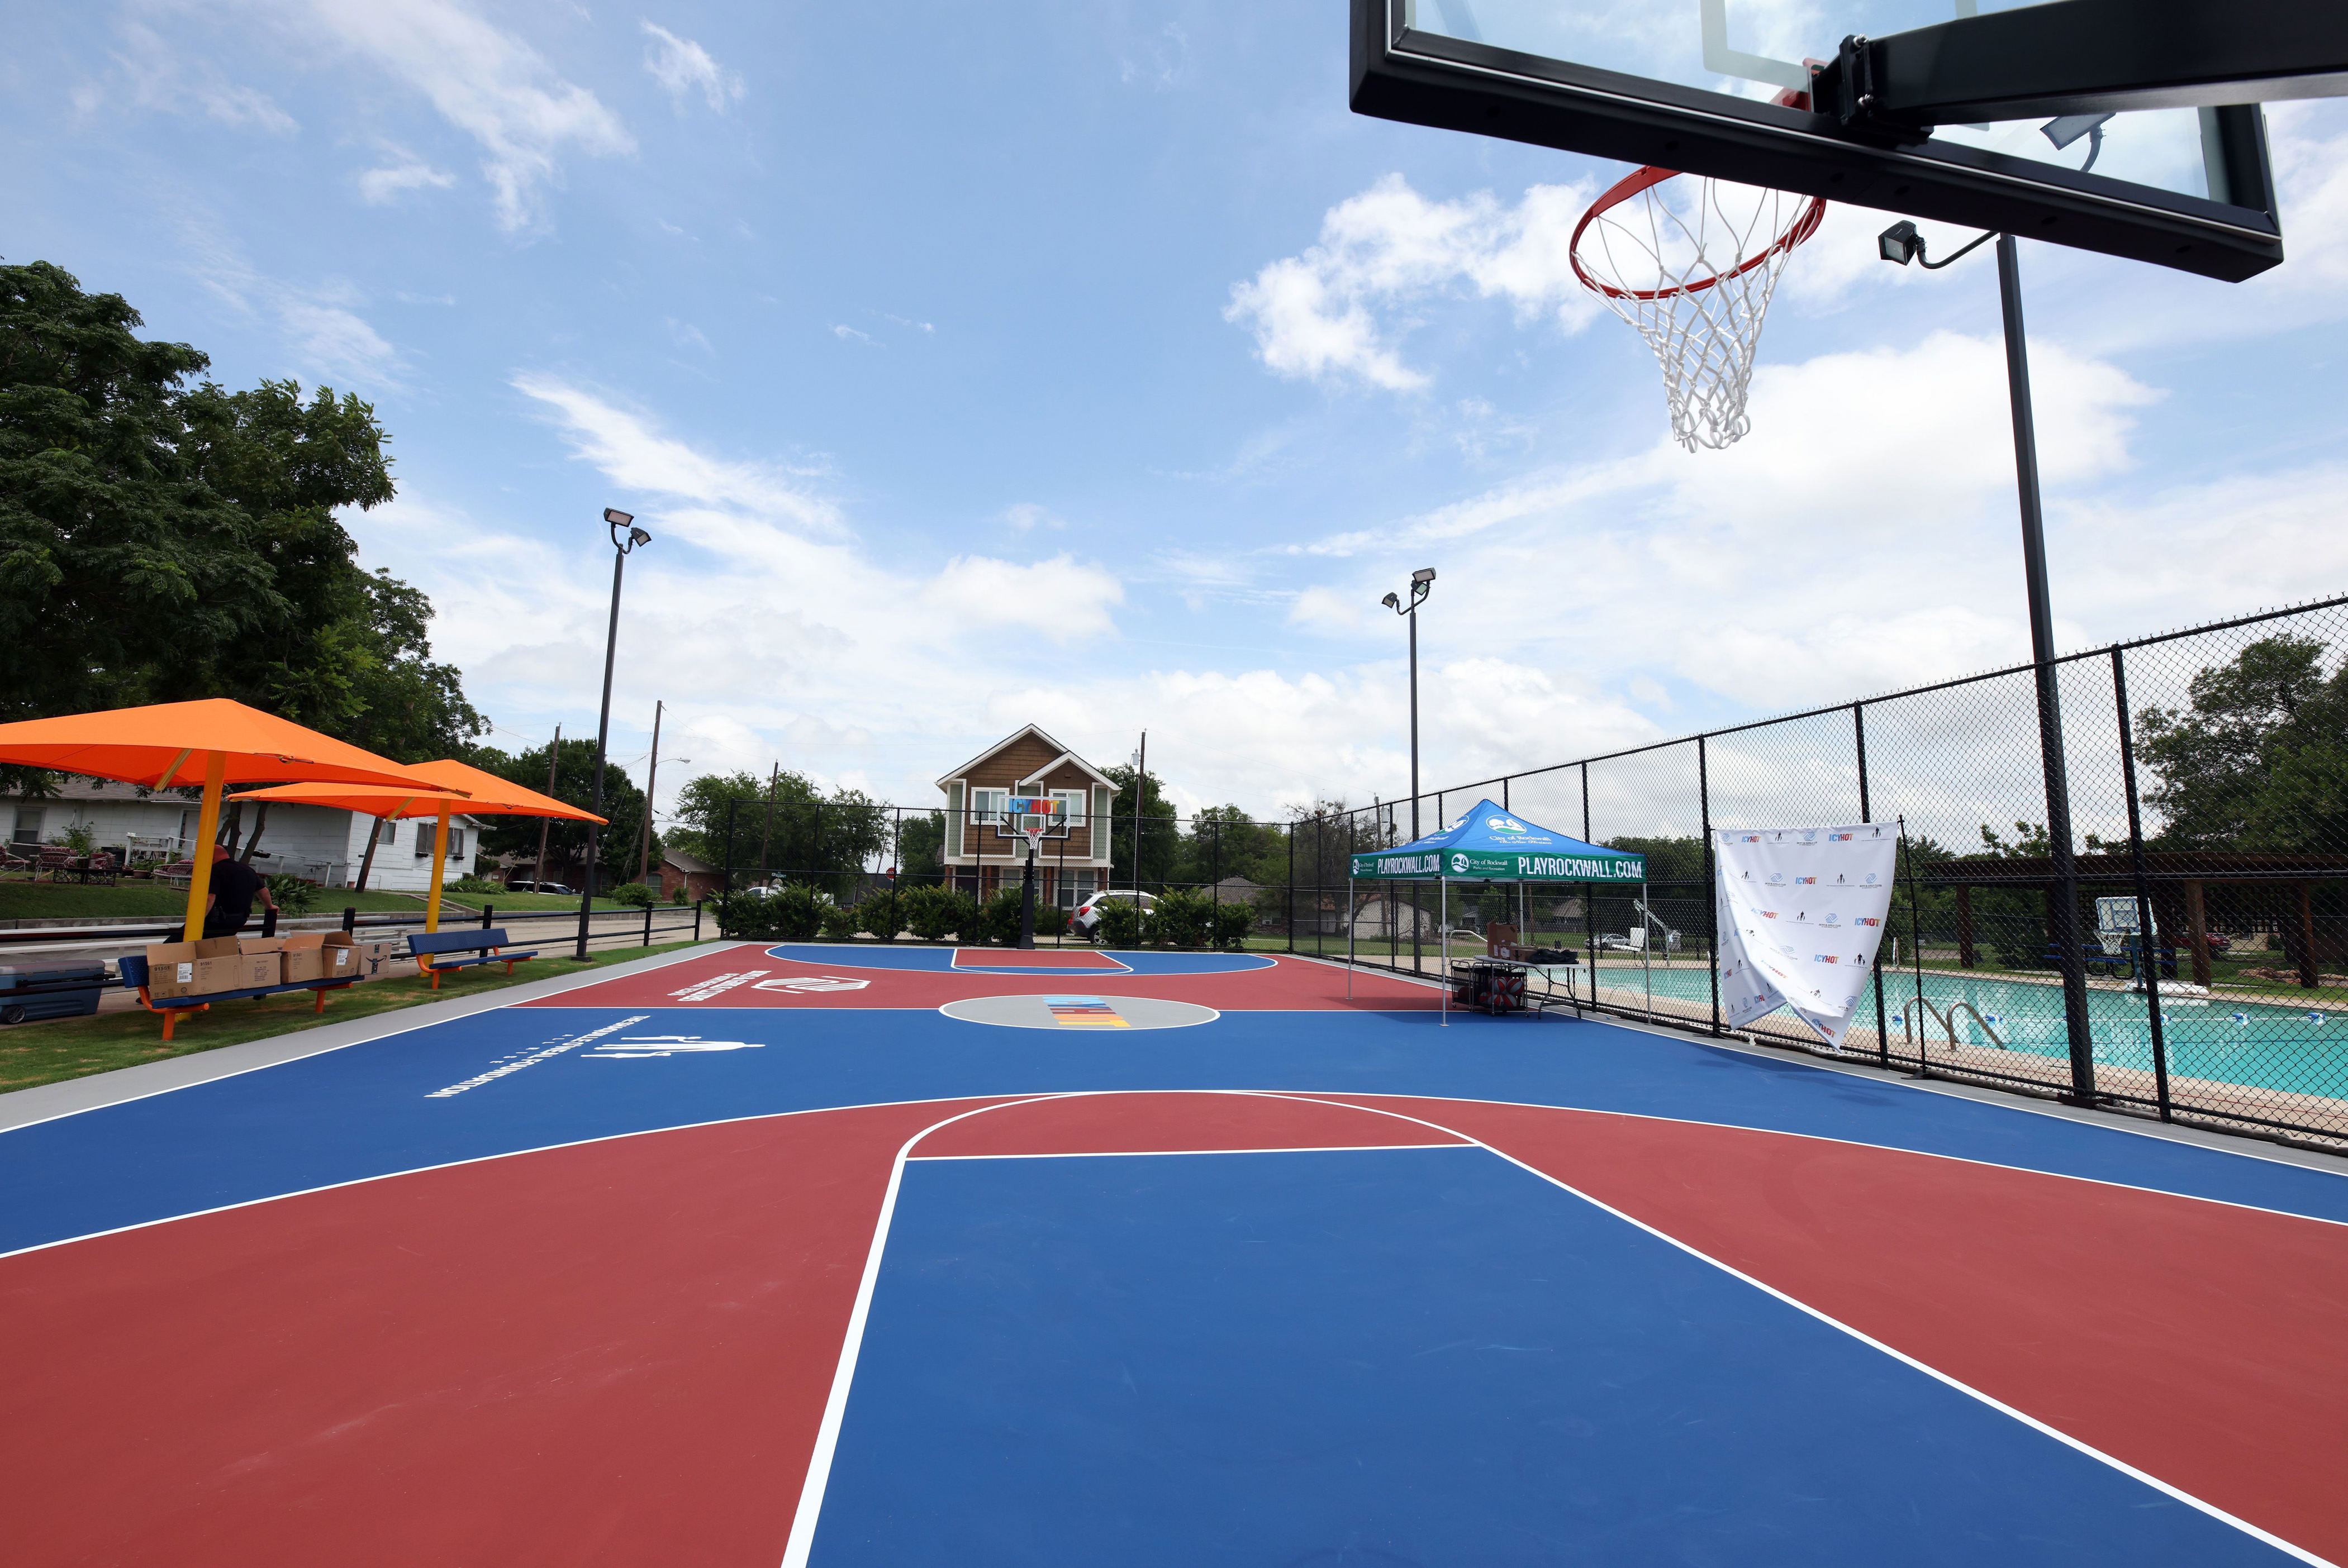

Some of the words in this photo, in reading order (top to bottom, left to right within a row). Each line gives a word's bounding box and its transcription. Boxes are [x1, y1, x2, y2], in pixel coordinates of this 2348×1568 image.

[1377, 854, 1440, 874] PLAYROCKWALL.COM
[1518, 856, 1642, 878] PLAYROCKWALL.COM
[424, 1059, 543, 1097] FOUNDATION
